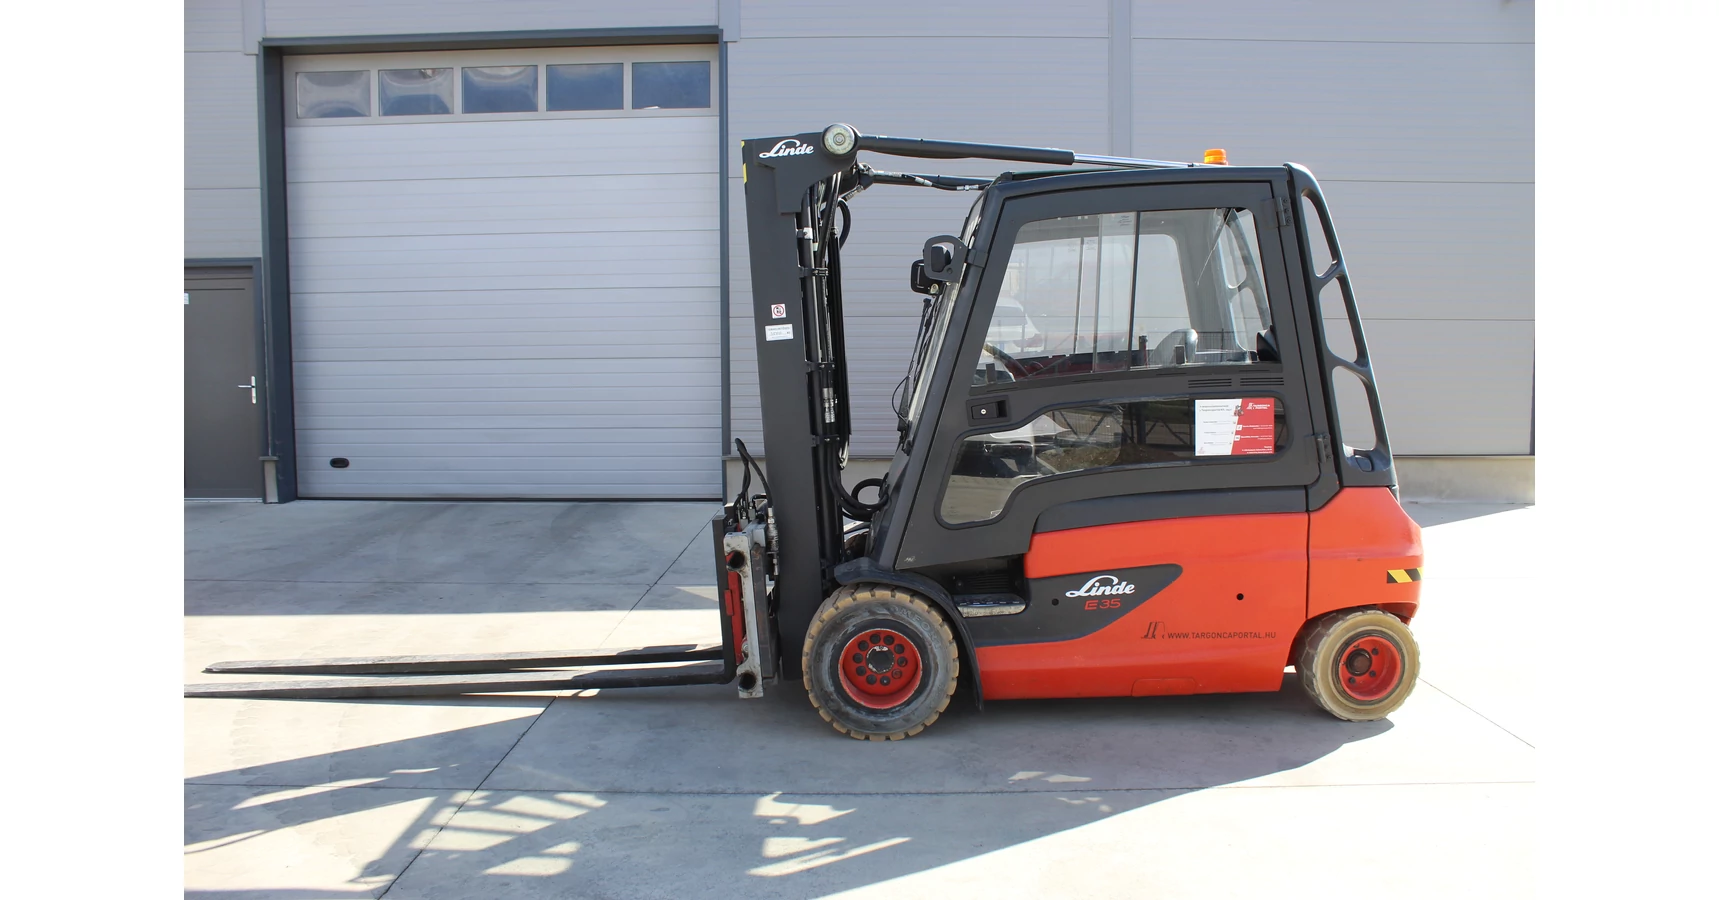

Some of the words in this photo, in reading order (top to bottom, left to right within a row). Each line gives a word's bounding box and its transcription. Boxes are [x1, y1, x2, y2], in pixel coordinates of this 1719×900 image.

[759, 139, 814, 158] Linde
[1065, 575, 1136, 597] Linde
[1167, 631, 1276, 639] WWW.TARGONCAPORTAL.HU
